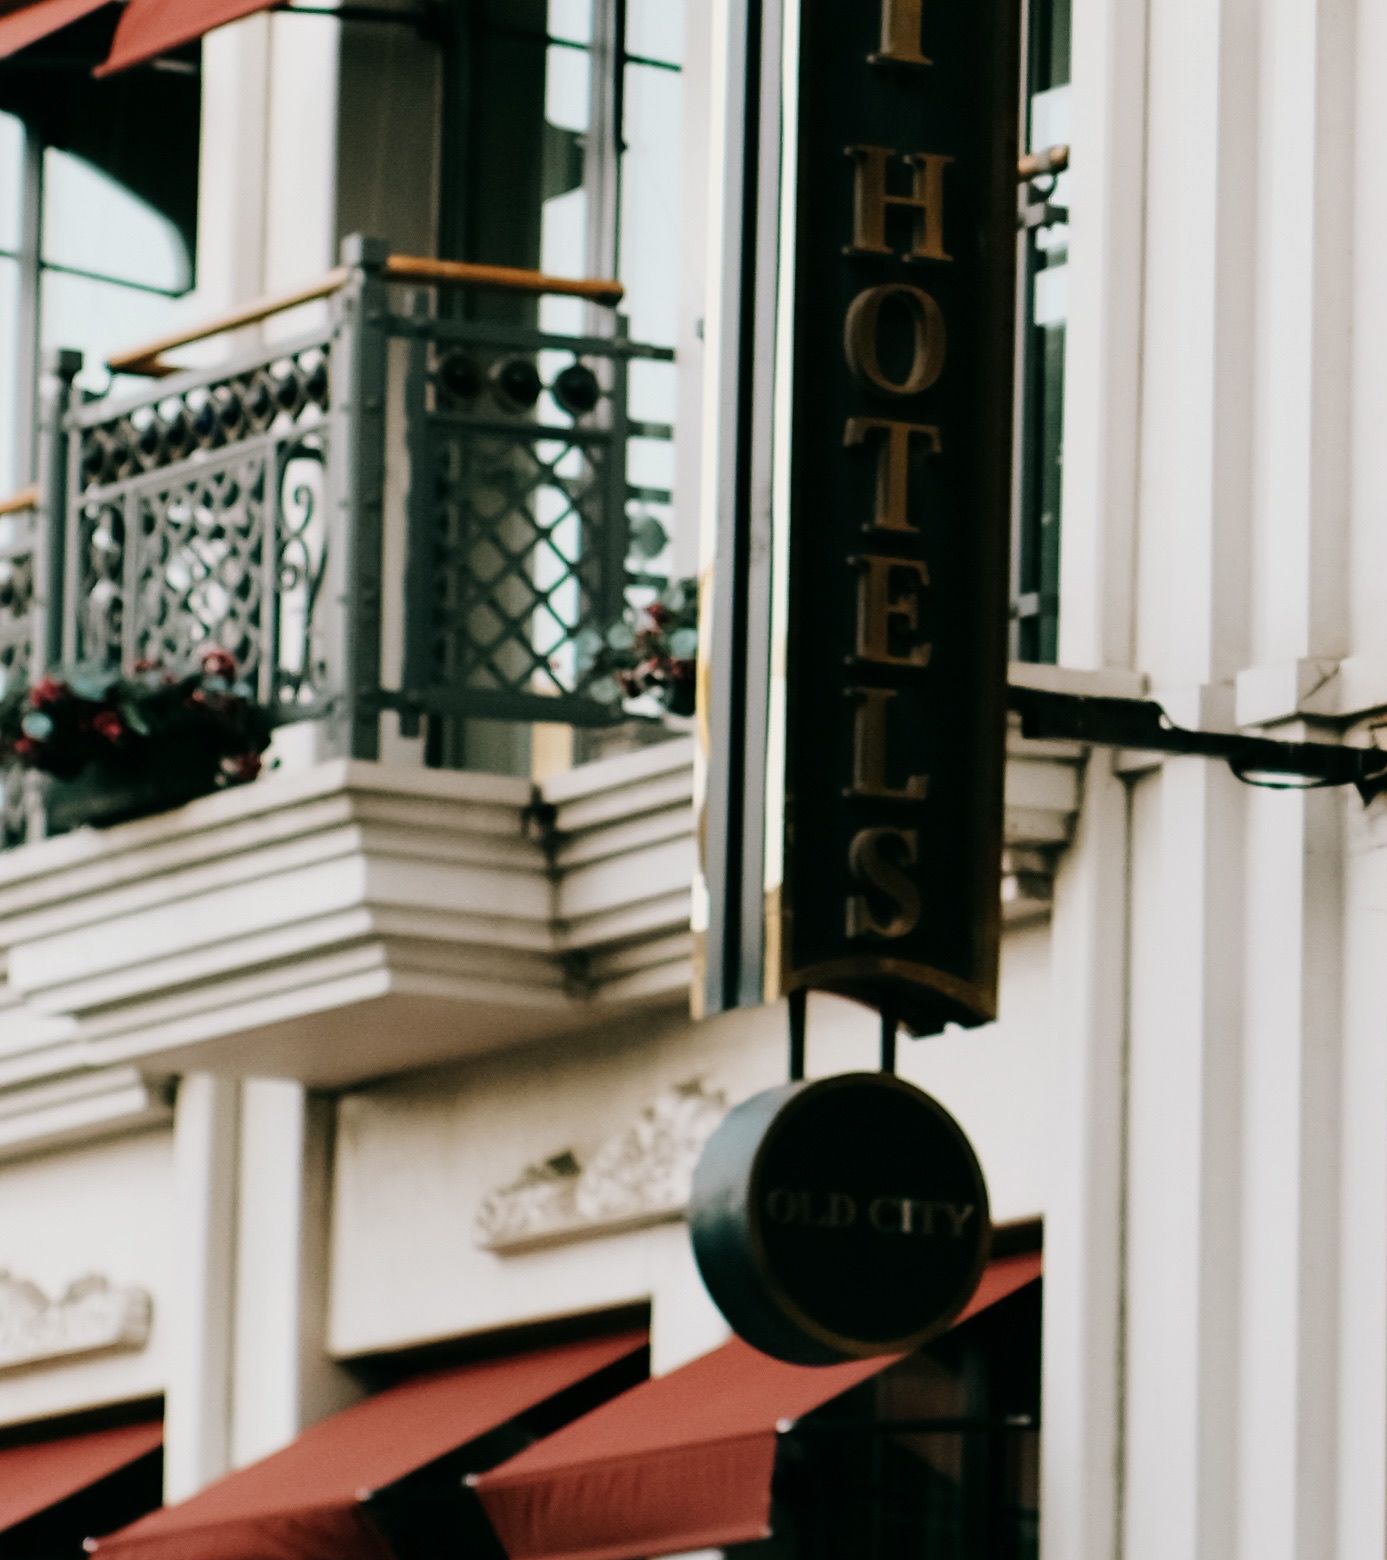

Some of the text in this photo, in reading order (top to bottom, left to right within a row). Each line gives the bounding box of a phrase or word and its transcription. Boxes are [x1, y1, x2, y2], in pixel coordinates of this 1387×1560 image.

[842, 144, 956, 944] HOTELS
[766, 1189, 976, 1236] OLD CITY
